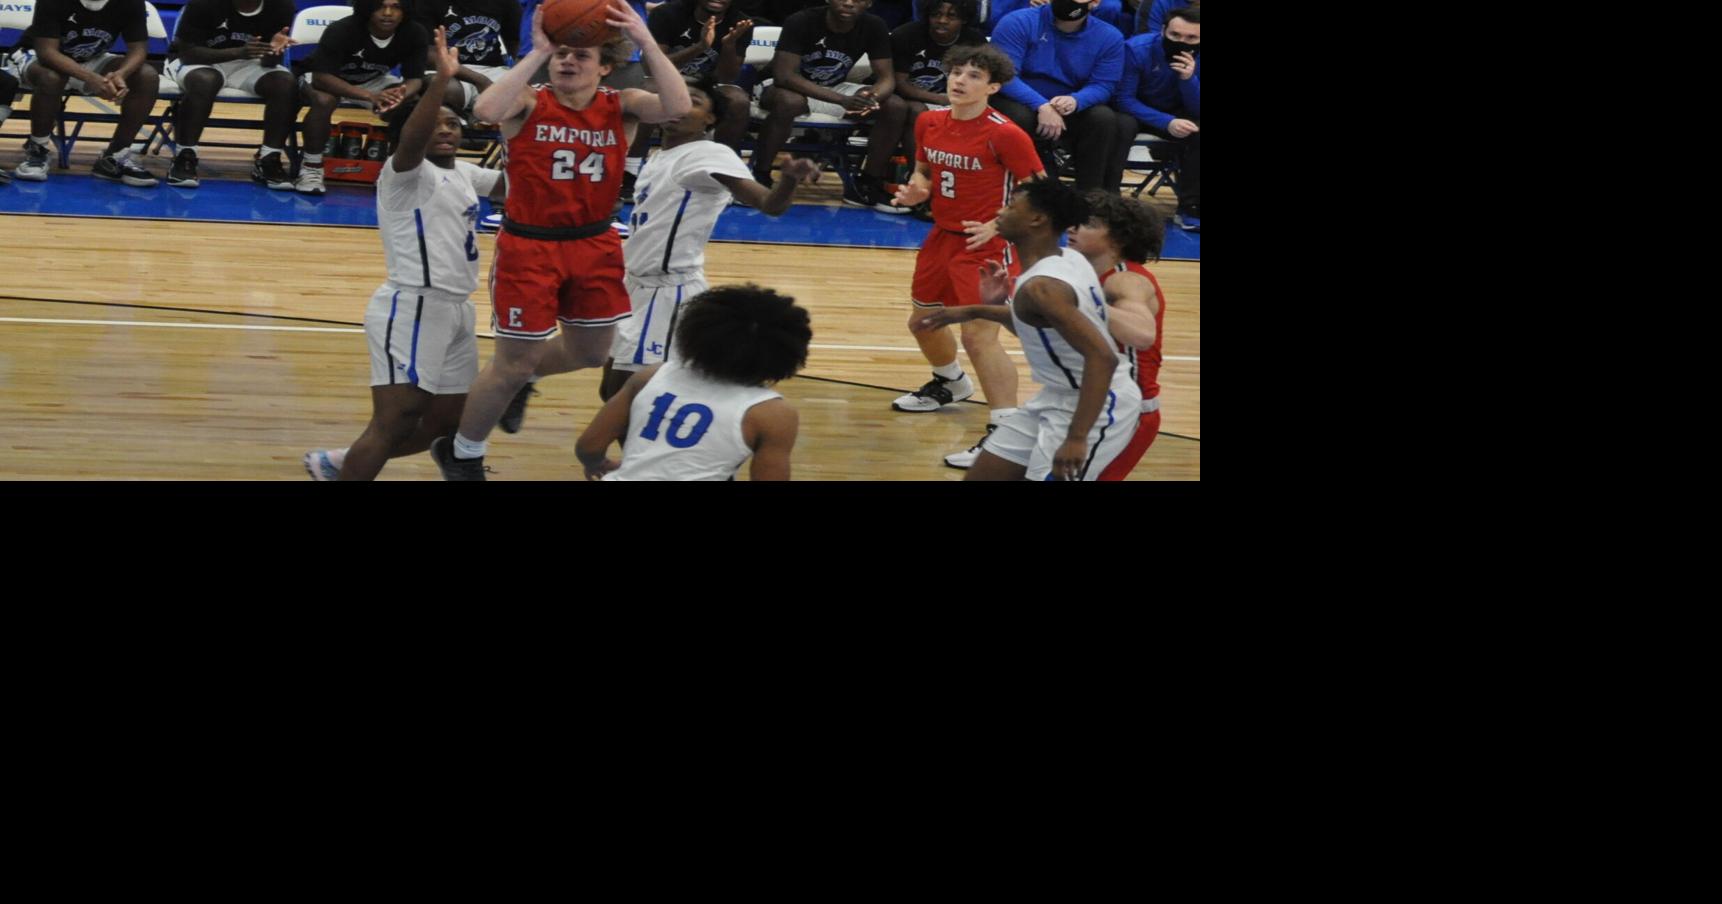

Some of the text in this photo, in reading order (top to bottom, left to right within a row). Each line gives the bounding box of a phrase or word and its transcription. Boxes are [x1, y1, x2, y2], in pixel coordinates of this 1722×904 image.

[306, 18, 332, 26] BLU
[535, 124, 617, 147] EMPORIA
[551, 149, 604, 182] 24
[923, 146, 983, 170] MPORIA
[941, 171, 955, 198] 2
[509, 307, 522, 327] E
[646, 341, 662, 355] JC
[639, 392, 714, 449] 10
